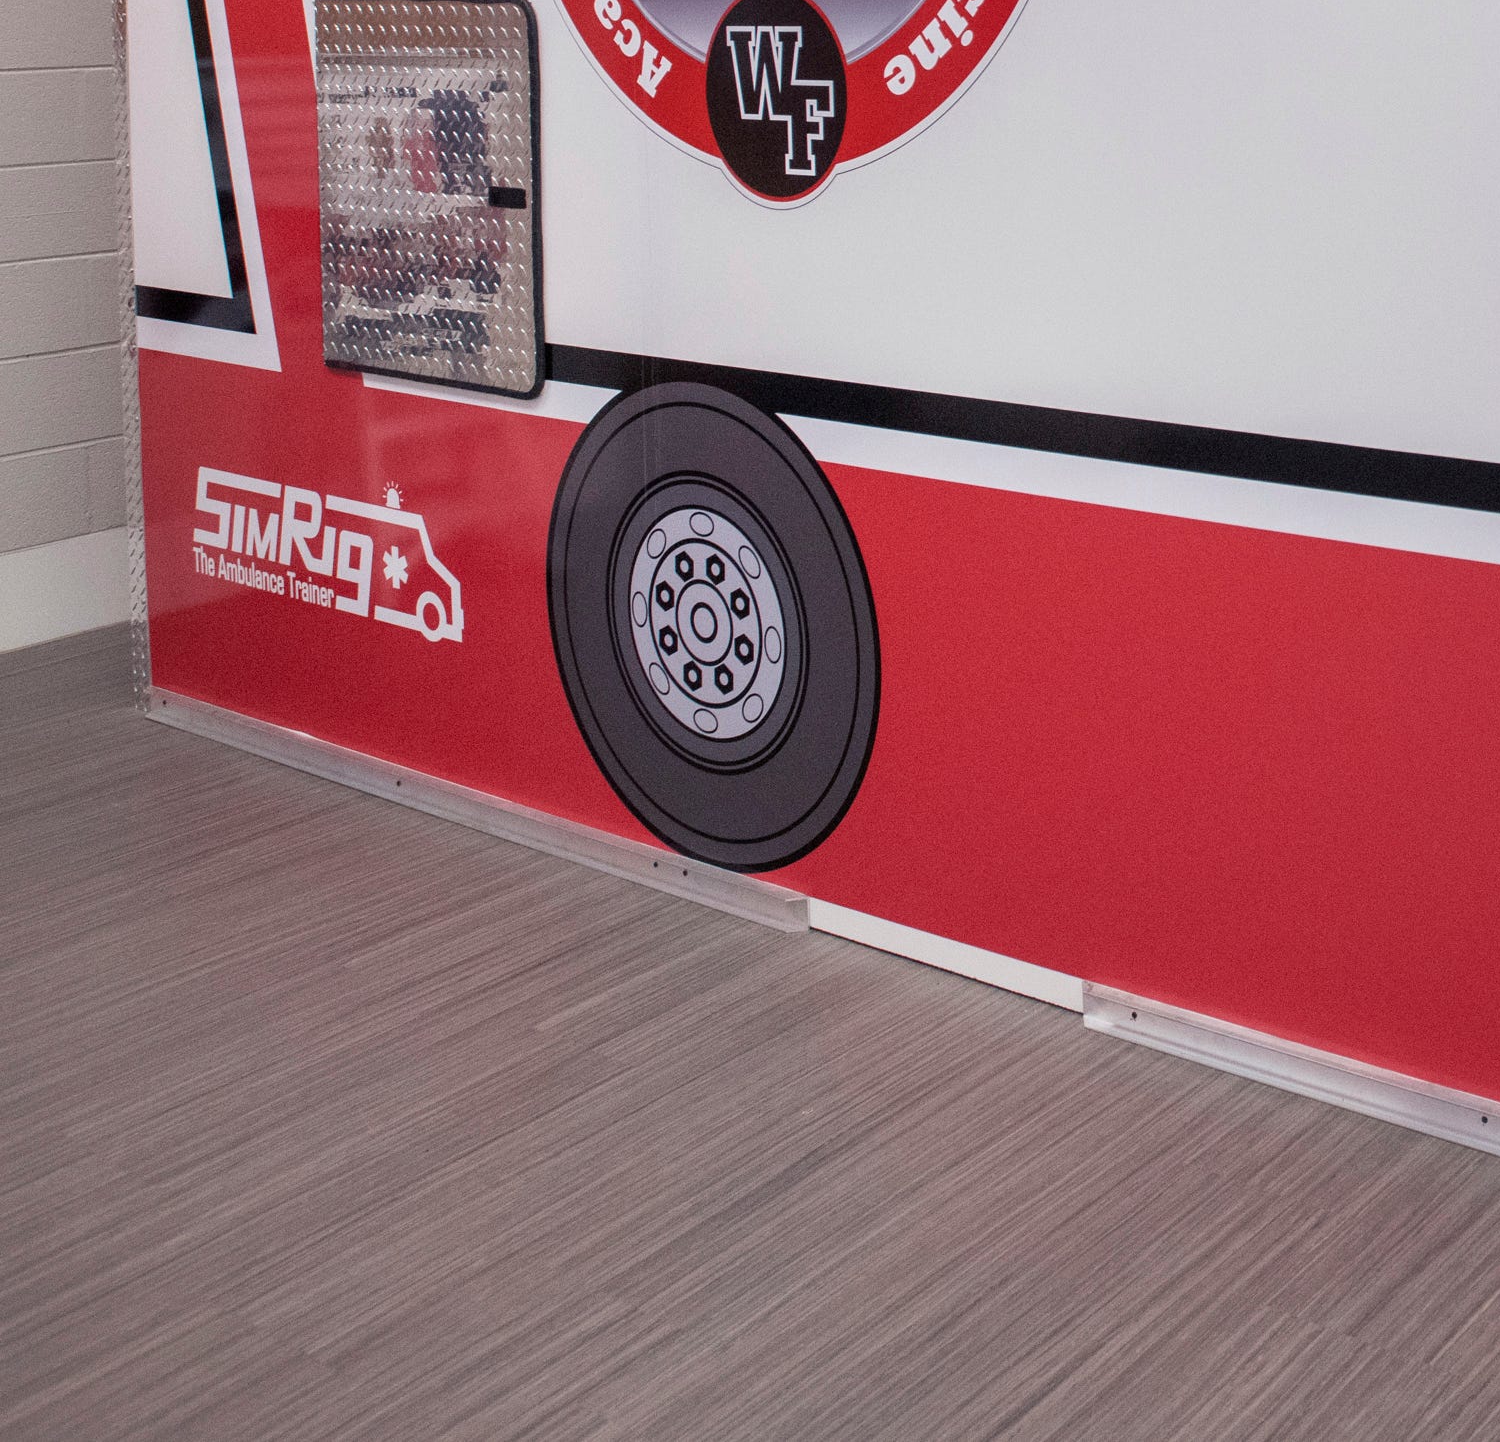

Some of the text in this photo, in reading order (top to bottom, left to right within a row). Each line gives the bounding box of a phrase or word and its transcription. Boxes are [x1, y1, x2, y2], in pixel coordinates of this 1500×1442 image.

[192, 546, 335, 609] The Ambulance Trainer
